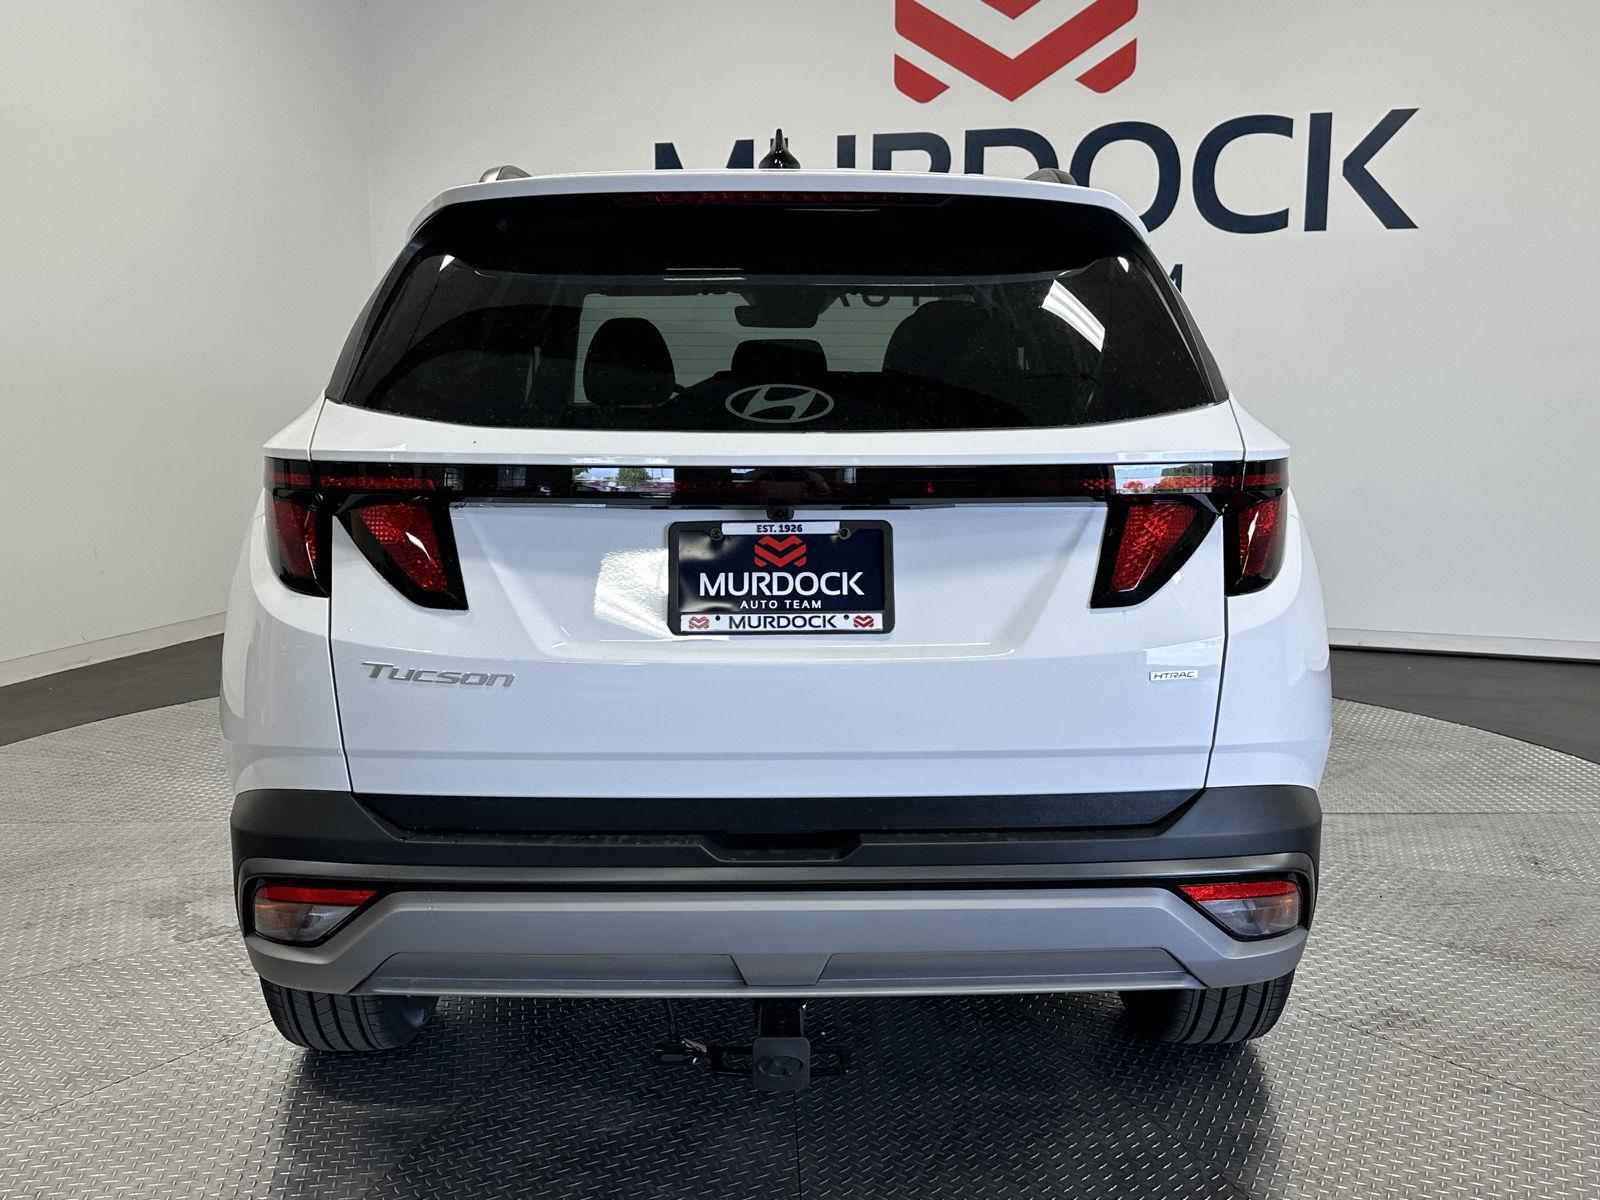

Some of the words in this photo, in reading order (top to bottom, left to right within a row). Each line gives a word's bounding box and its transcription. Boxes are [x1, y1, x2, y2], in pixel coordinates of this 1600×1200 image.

[756, 524, 776, 533] EST.
[779, 523, 803, 533] 1926
[699, 571, 865, 597] MURDOCK
[740, 600, 777, 610] AUTO
[786, 600, 822, 609] TEAM
[729, 615, 837, 629] MURDOCK
[1153, 671, 1196, 679] HTRAC
